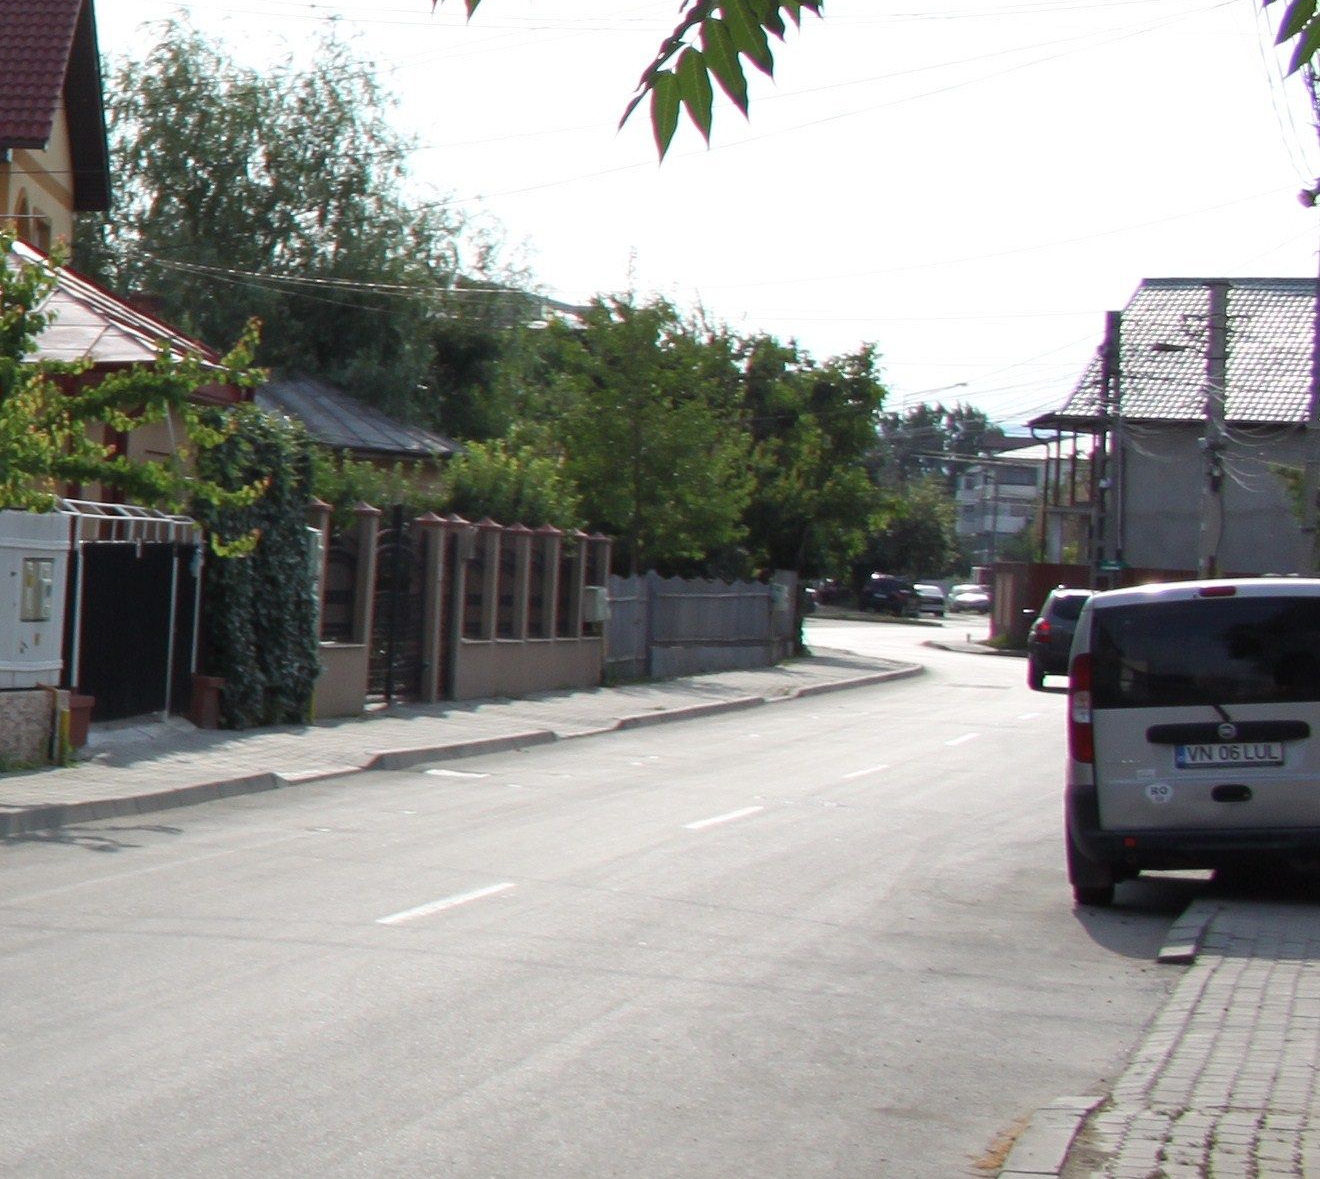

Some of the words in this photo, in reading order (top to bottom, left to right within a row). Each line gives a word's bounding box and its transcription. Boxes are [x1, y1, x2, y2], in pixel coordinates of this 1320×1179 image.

[1187, 745, 1212, 761] VN
[1219, 745, 1240, 760] 06
[1243, 744, 1278, 760] LUL
